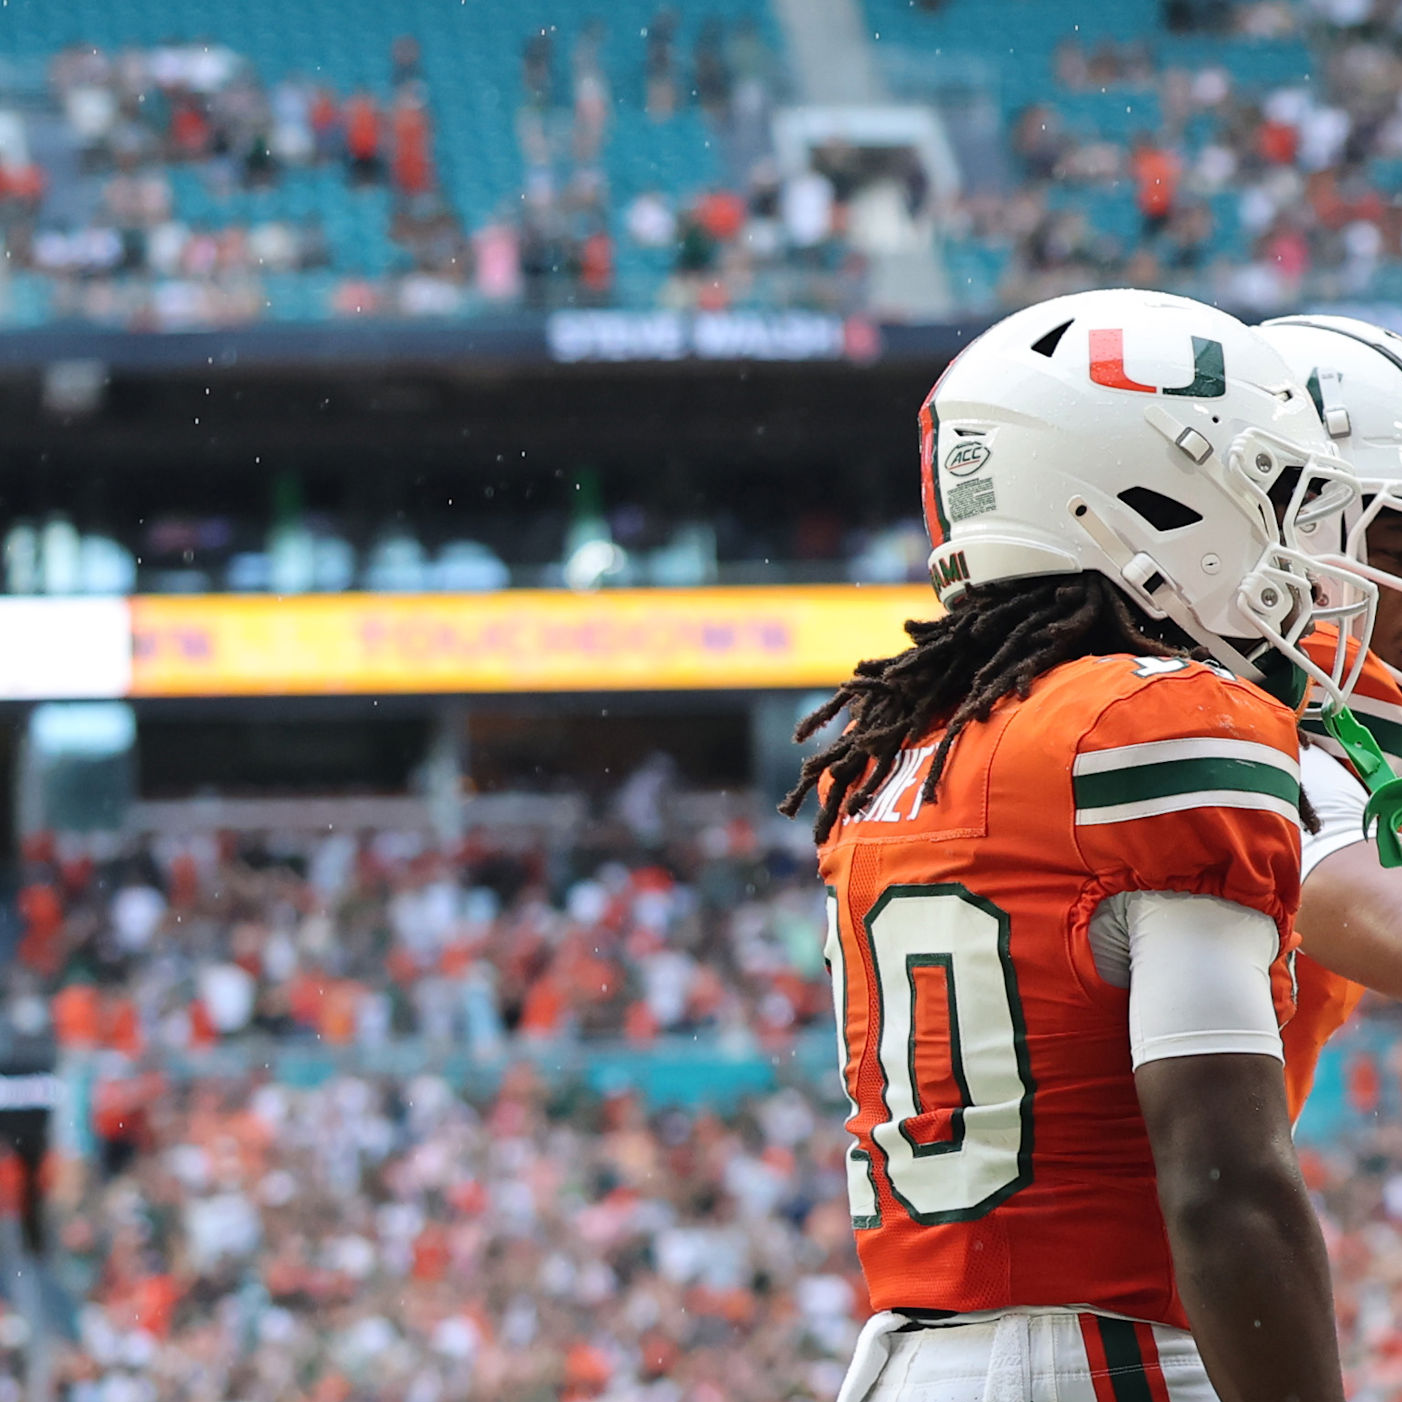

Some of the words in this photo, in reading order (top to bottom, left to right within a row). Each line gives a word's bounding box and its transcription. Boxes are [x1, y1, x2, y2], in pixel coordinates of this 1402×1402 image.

[1089, 328, 1226, 397] U
[951, 446, 982, 466] ACC
[930, 550, 971, 593] AMI
[825, 882, 1037, 1229] 10
